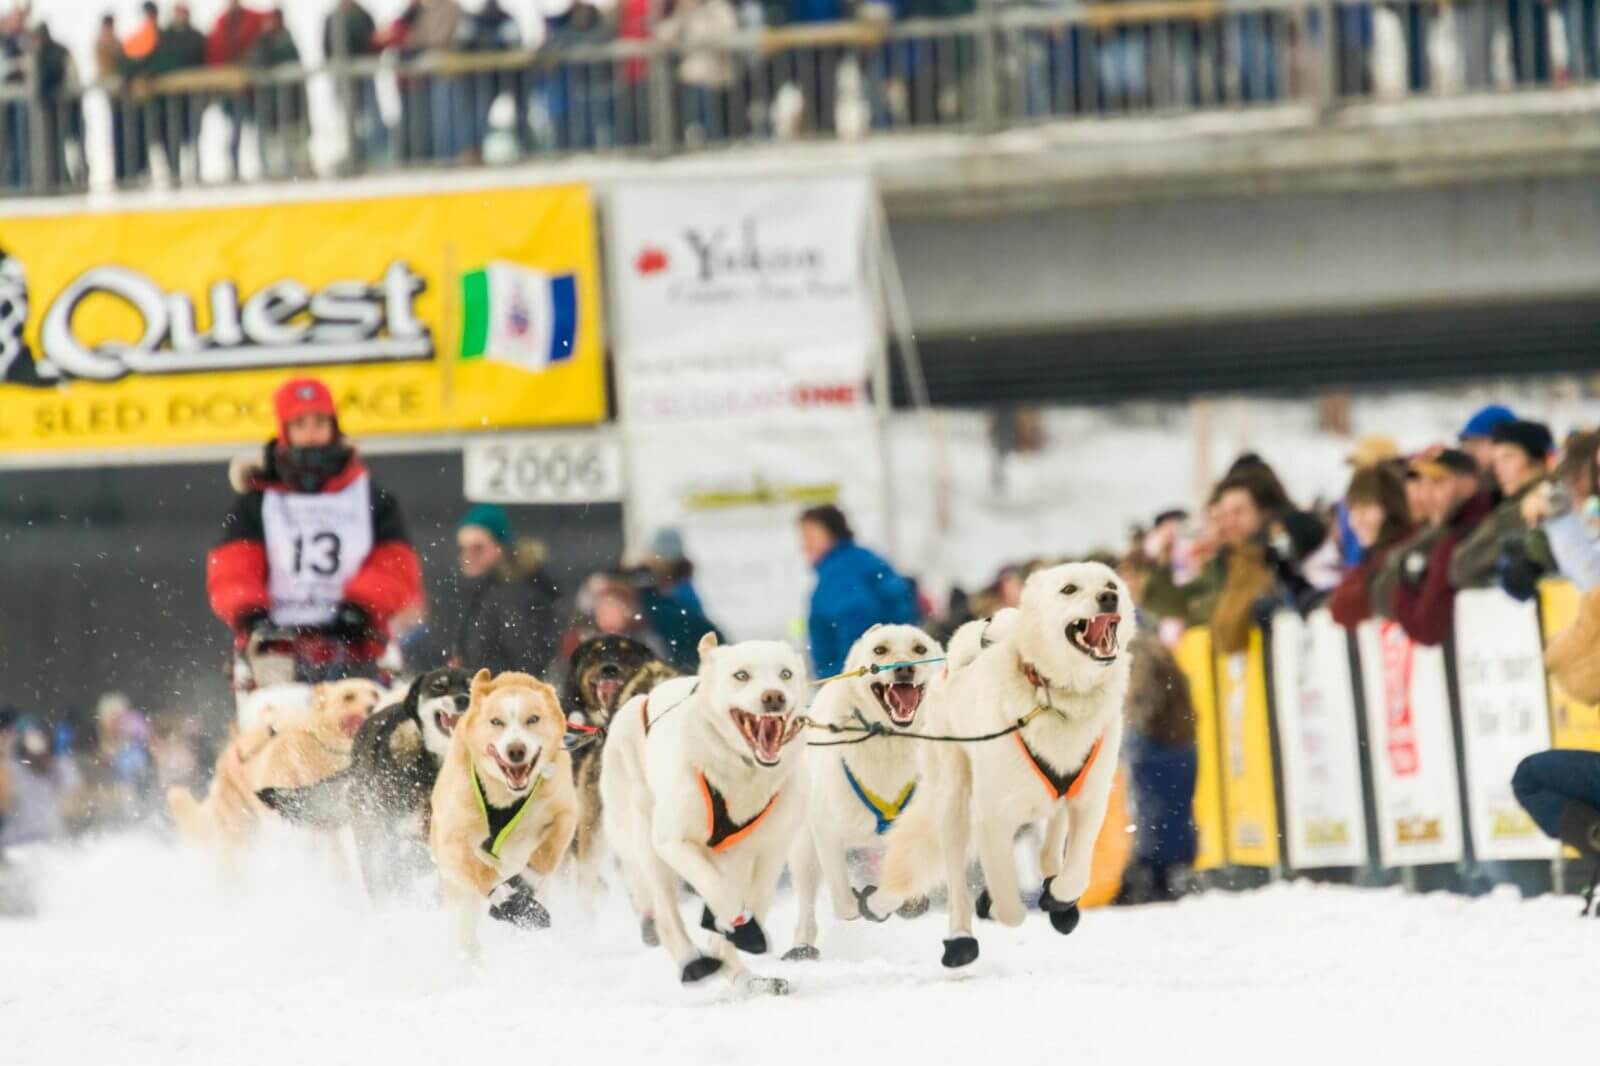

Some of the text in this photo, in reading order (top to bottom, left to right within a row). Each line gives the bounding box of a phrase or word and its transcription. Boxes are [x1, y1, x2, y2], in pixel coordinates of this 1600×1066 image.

[40, 260, 434, 380] Quest
[34, 402, 146, 437] SLED
[336, 381, 421, 417] ACE
[484, 447, 607, 493] 2006
[292, 531, 342, 577] 13
